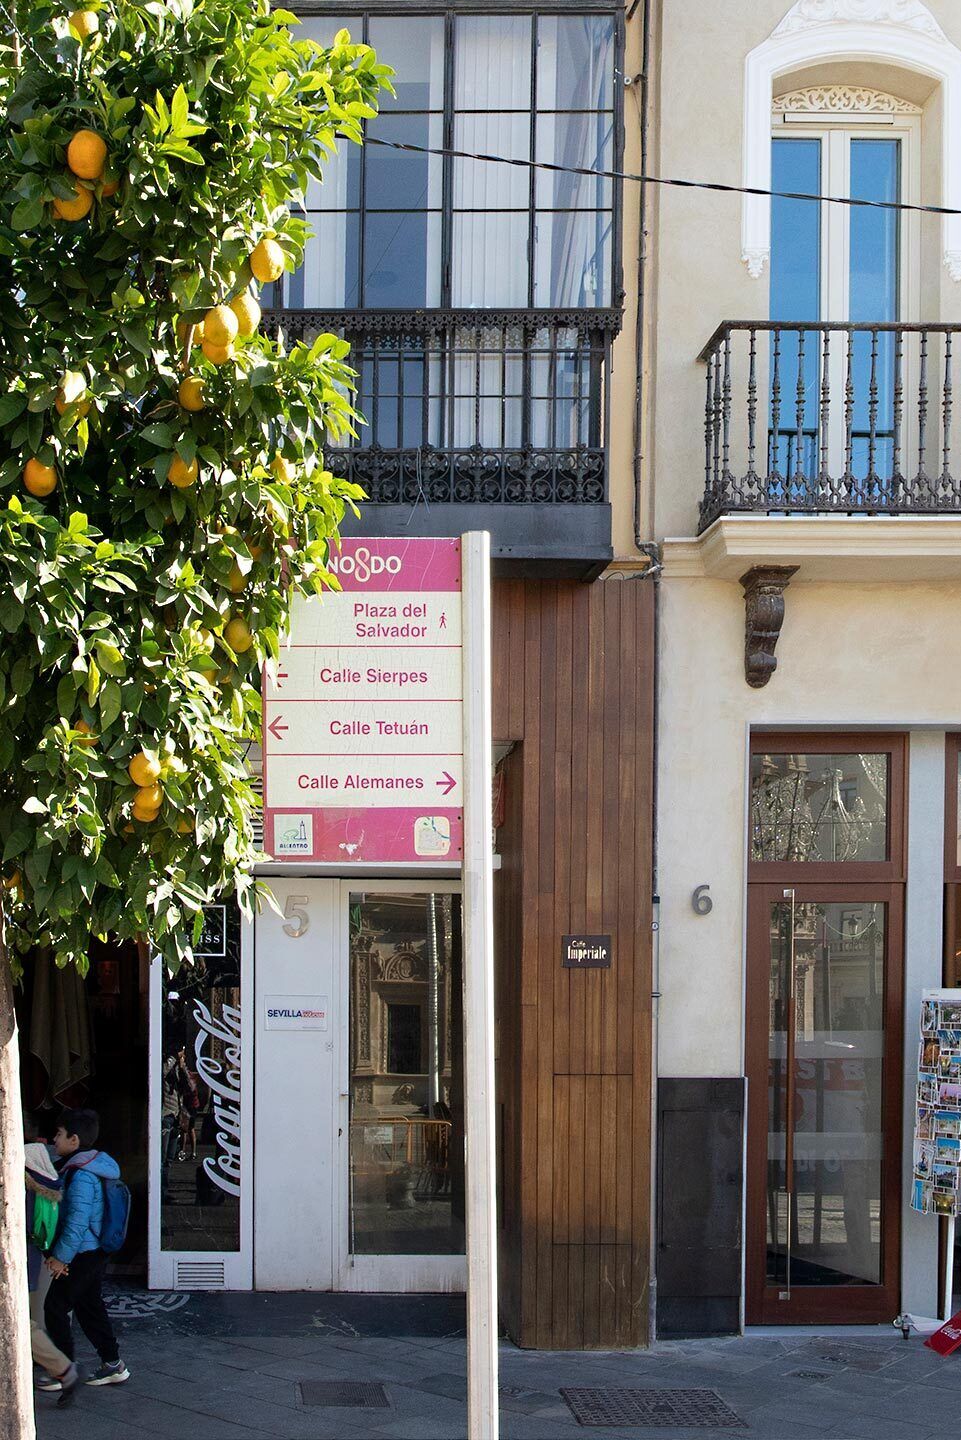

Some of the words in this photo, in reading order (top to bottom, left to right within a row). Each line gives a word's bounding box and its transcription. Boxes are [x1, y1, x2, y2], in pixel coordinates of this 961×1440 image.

[353, 603, 397, 618] Plaza
[402, 603, 427, 618] del
[355, 623, 428, 638] Salvador
[320, 668, 361, 683] Calle
[366, 668, 428, 687] Sierpes
[329, 720, 371, 735] Calle
[375, 719, 429, 735] Tetuán
[297, 774, 339, 789] Calle
[344, 774, 424, 789] Alemanes
[692, 884, 713, 916] 6
[282, 895, 310, 939] 5
[567, 945, 607, 962] Imperiale
[267, 1009, 303, 1018] SEVILLA
